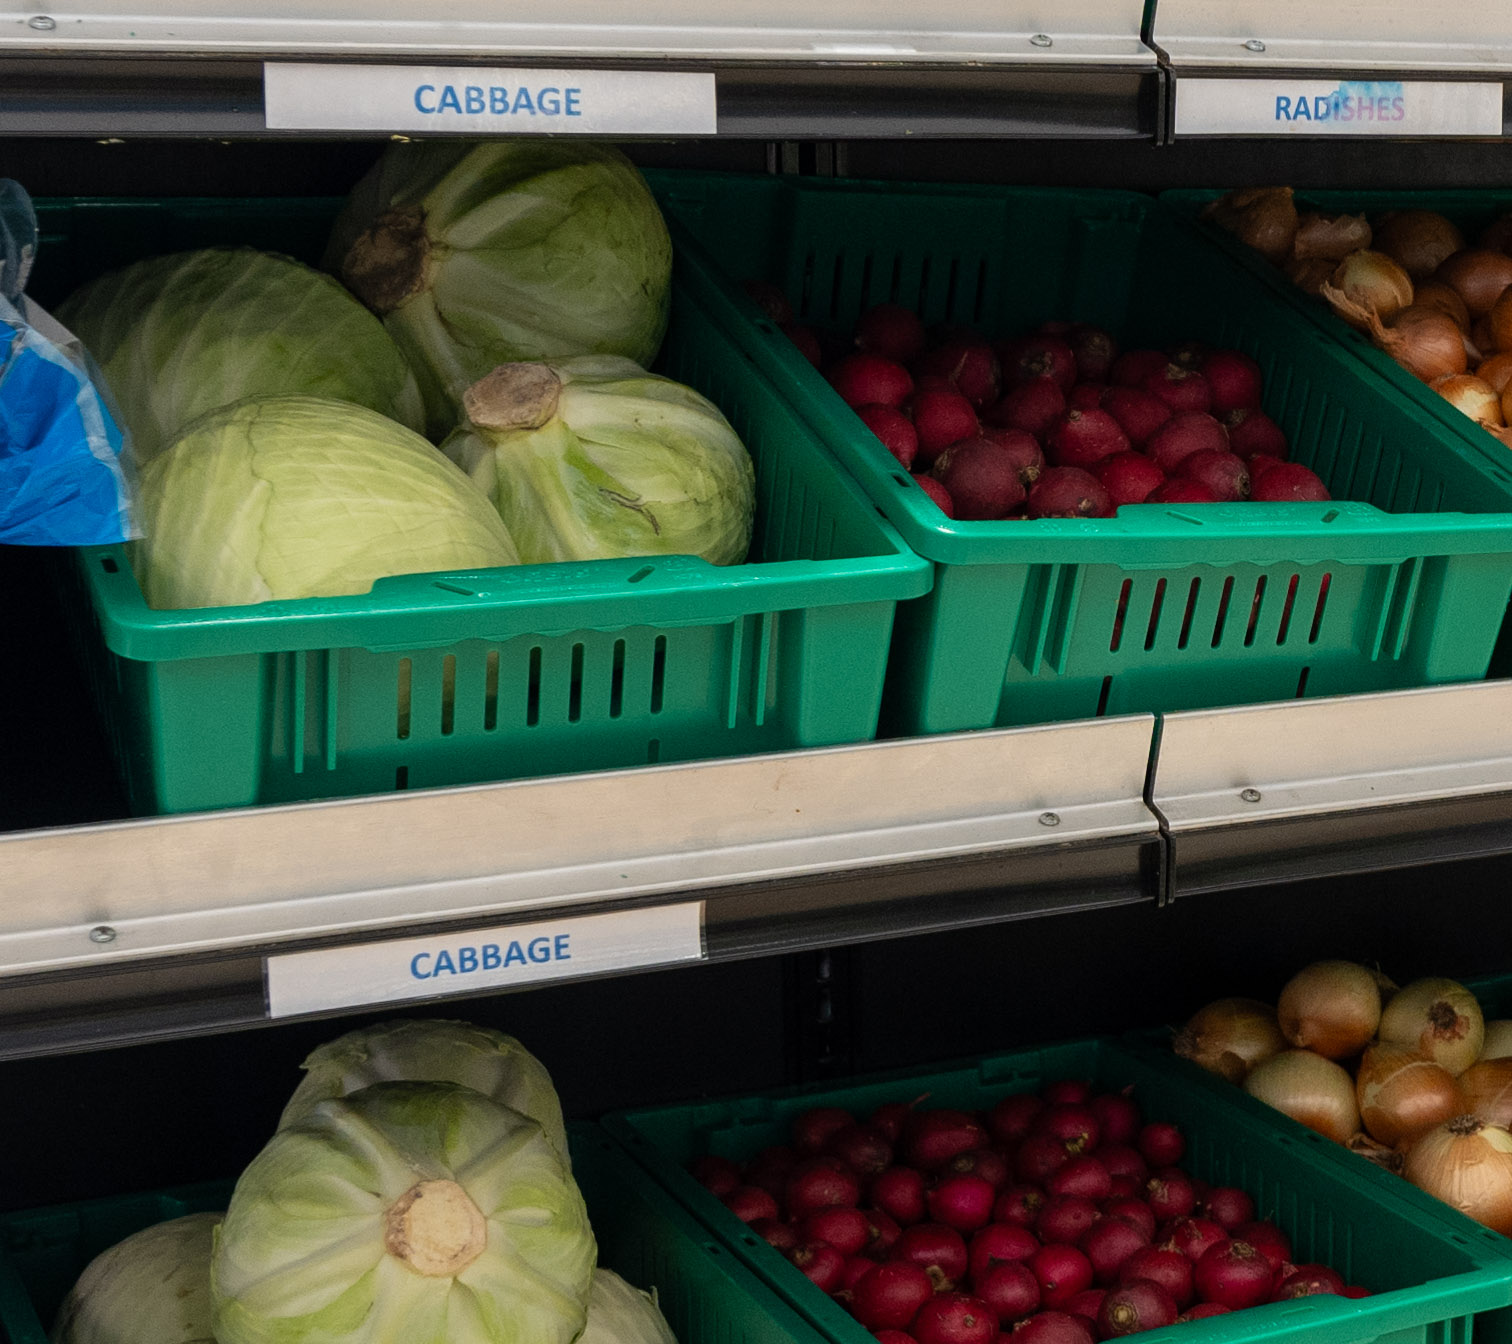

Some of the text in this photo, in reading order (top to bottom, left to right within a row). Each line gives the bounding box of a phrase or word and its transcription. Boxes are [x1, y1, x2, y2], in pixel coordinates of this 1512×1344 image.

[412, 83, 582, 118] CABBAGE
[1274, 95, 1405, 122] RADISHES
[410, 933, 572, 980] CABBAGE
